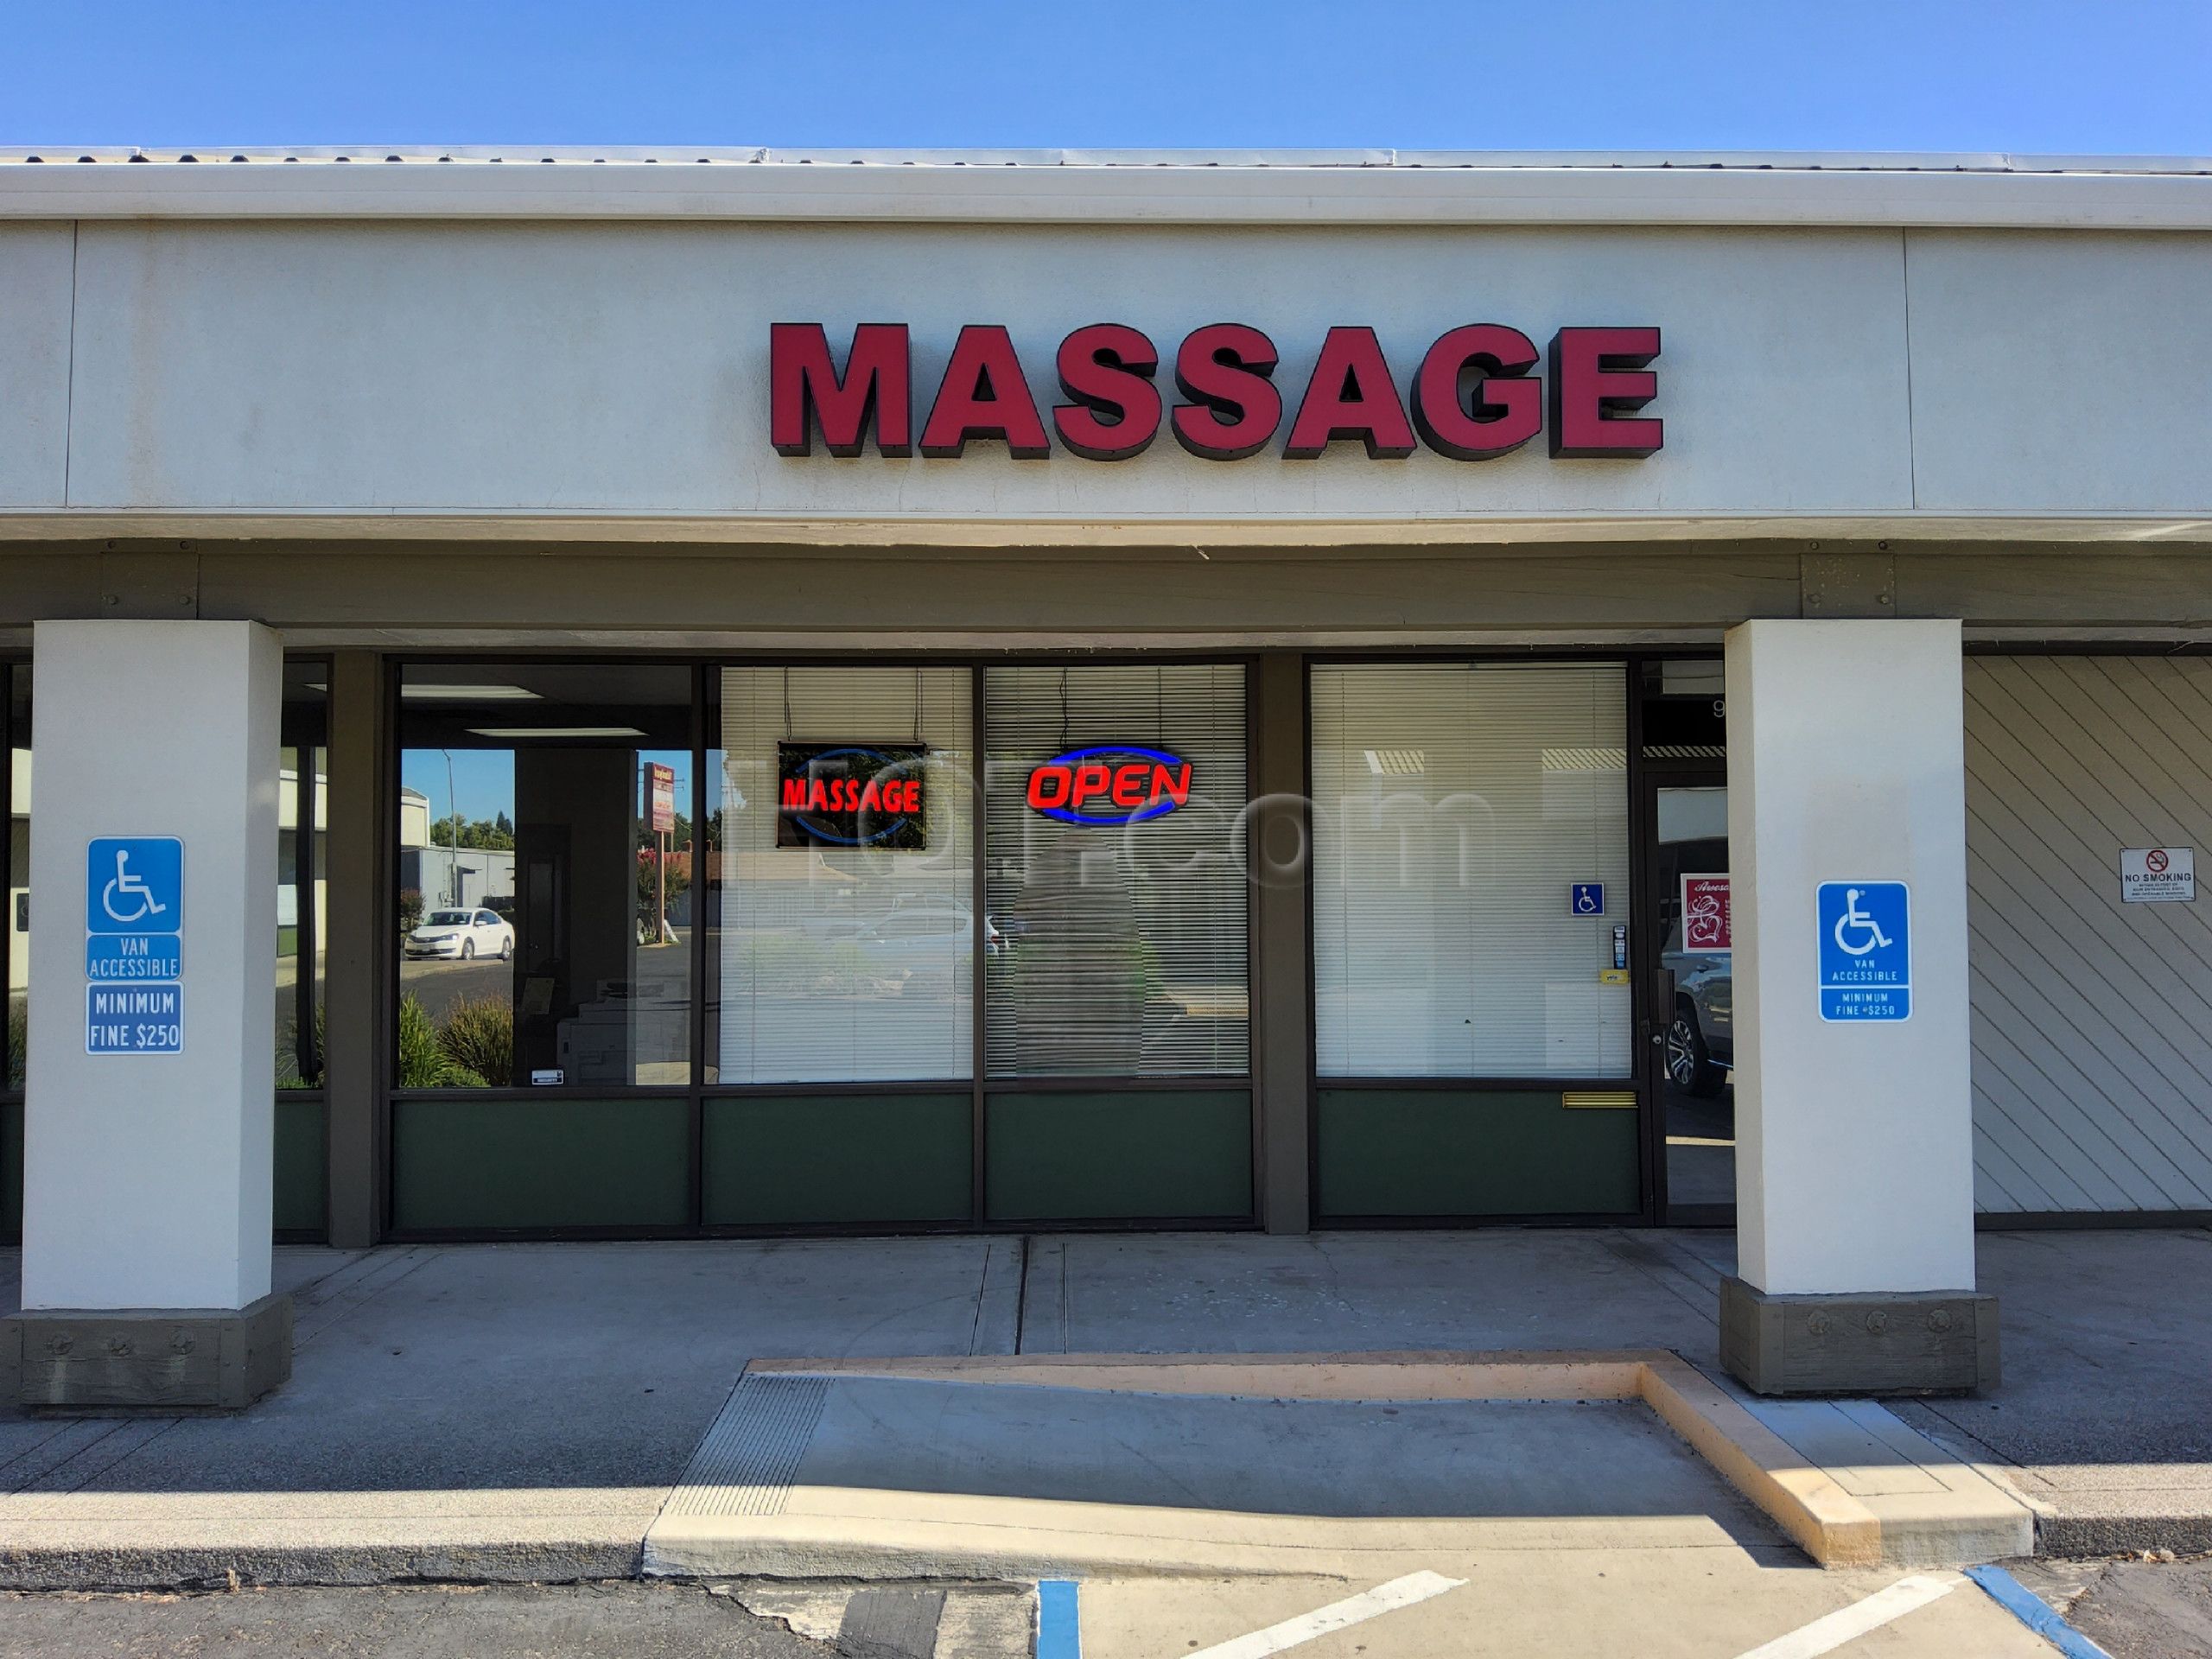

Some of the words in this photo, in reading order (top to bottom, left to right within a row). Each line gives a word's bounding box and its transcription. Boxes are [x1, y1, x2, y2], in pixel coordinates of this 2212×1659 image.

[770, 322, 1664, 461] MASSAGE
[1027, 762, 1193, 810] OPEN
[783, 778, 921, 814] MASSAGE
[1694, 881, 1729, 892] Aweso
[2125, 874, 2140, 882] NO
[2143, 873, 2192, 882] SMOKING
[120, 938, 149, 957] VAN
[89, 957, 180, 977] ACCESSIBLE
[1854, 959, 1876, 969] VAN
[1831, 970, 1898, 982] ACCESSIBLE
[96, 992, 175, 1014] MINIMUM
[1841, 993, 1889, 1003] MINIMUM
[1835, 1005, 1860, 1015] FINE
[1867, 1005, 1896, 1016] $250
[90, 1024, 130, 1046] FINE
[136, 1022, 180, 1049] $250
